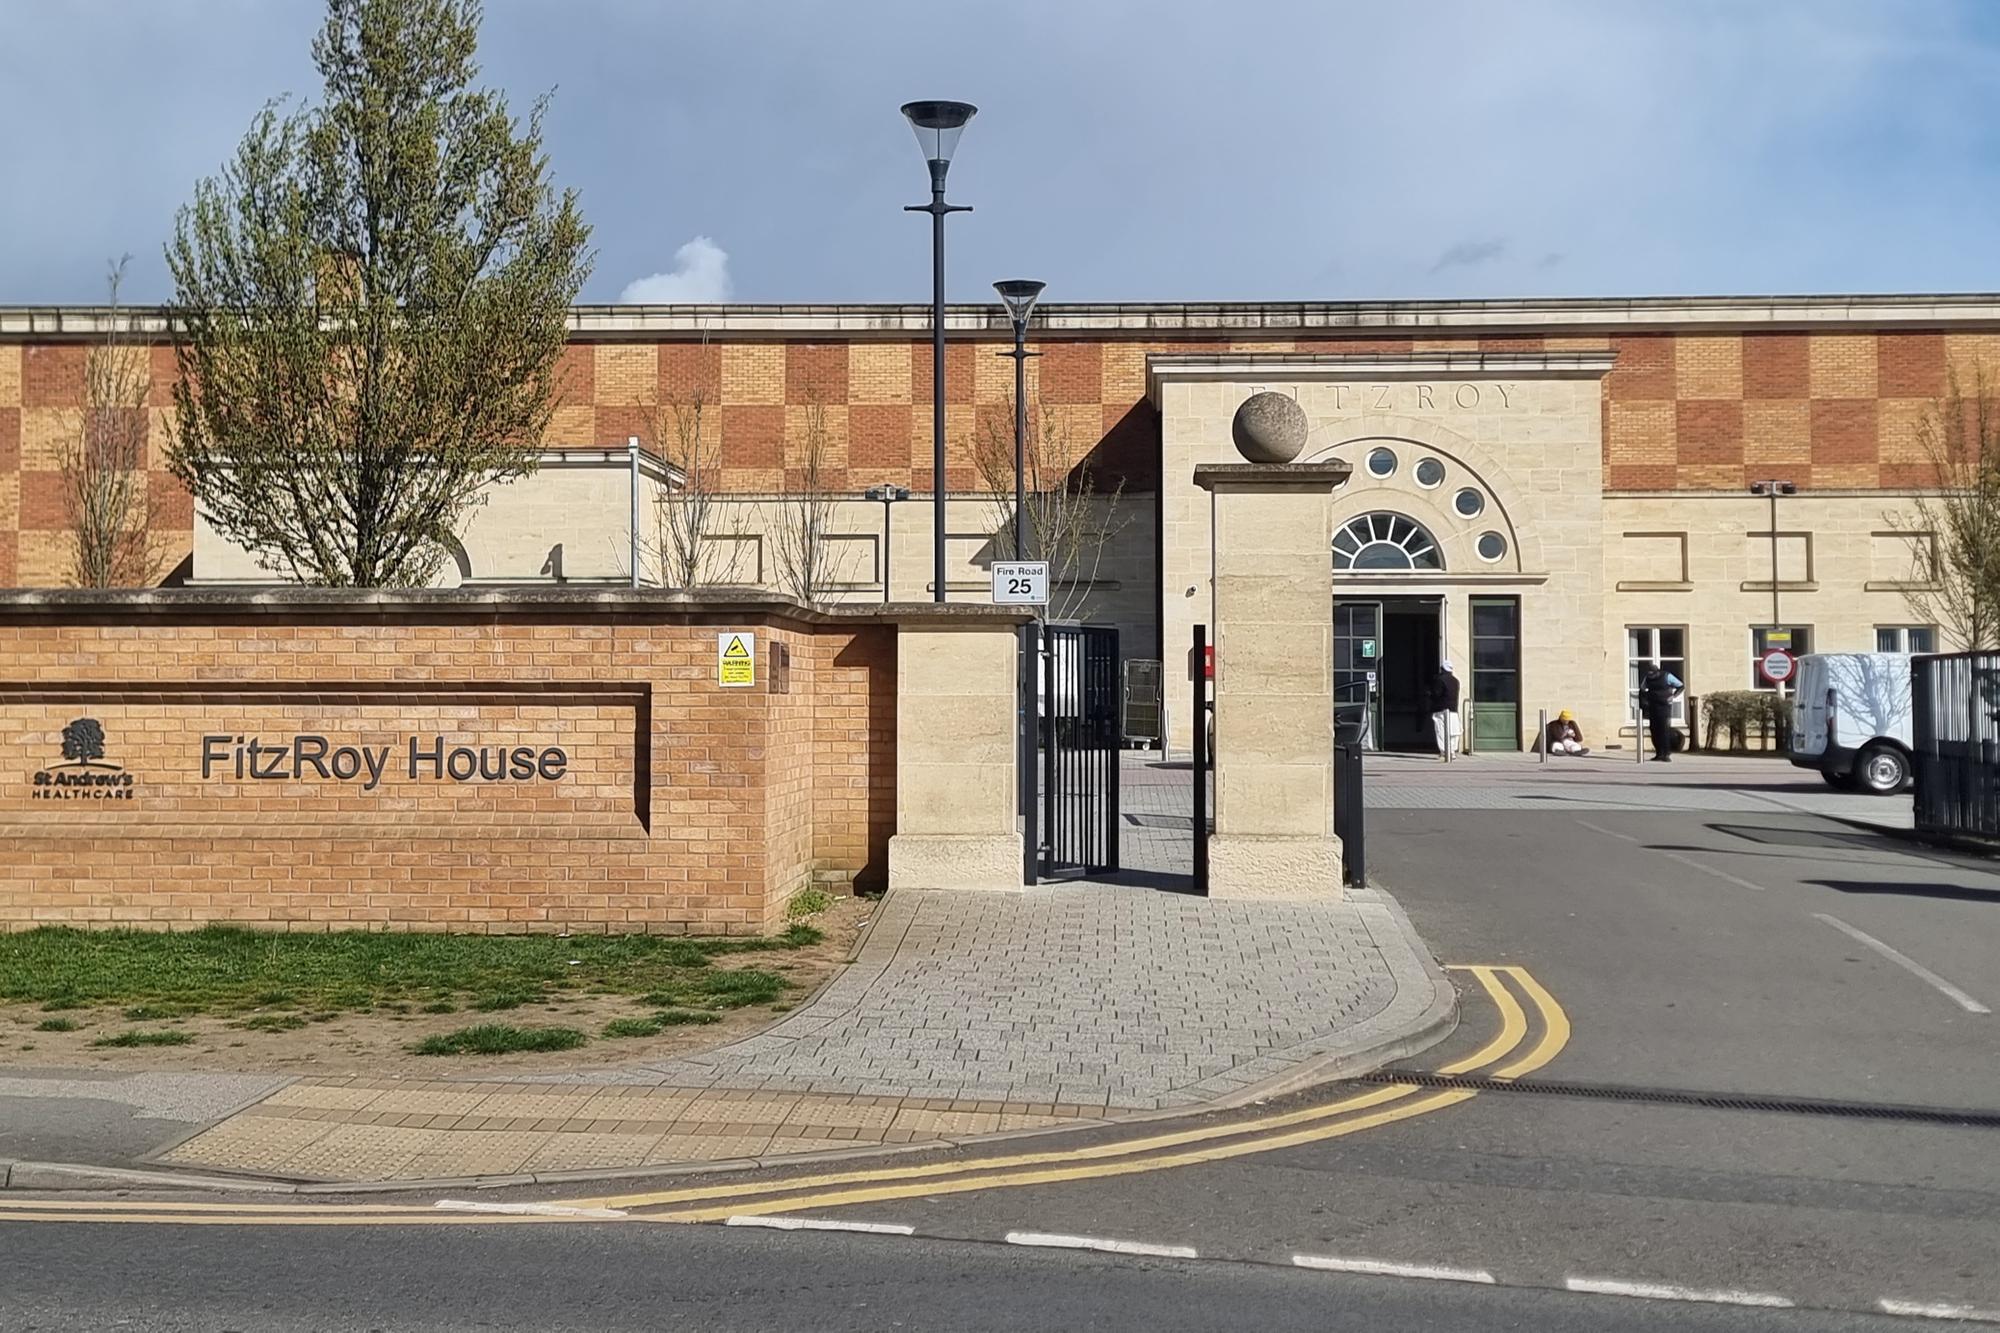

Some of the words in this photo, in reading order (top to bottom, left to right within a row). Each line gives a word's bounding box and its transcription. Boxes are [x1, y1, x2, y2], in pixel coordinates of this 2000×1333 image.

[997, 567, 1015, 575] Fire
[1018, 567, 1043, 575] Road
[1008, 578, 1032, 594] 25
[202, 735, 389, 790] FitzRoy
[409, 735, 568, 780] House
[33, 771, 52, 786] St
[54, 771, 133, 786] Andrew's
[32, 789, 133, 799] HEALTHCARE
